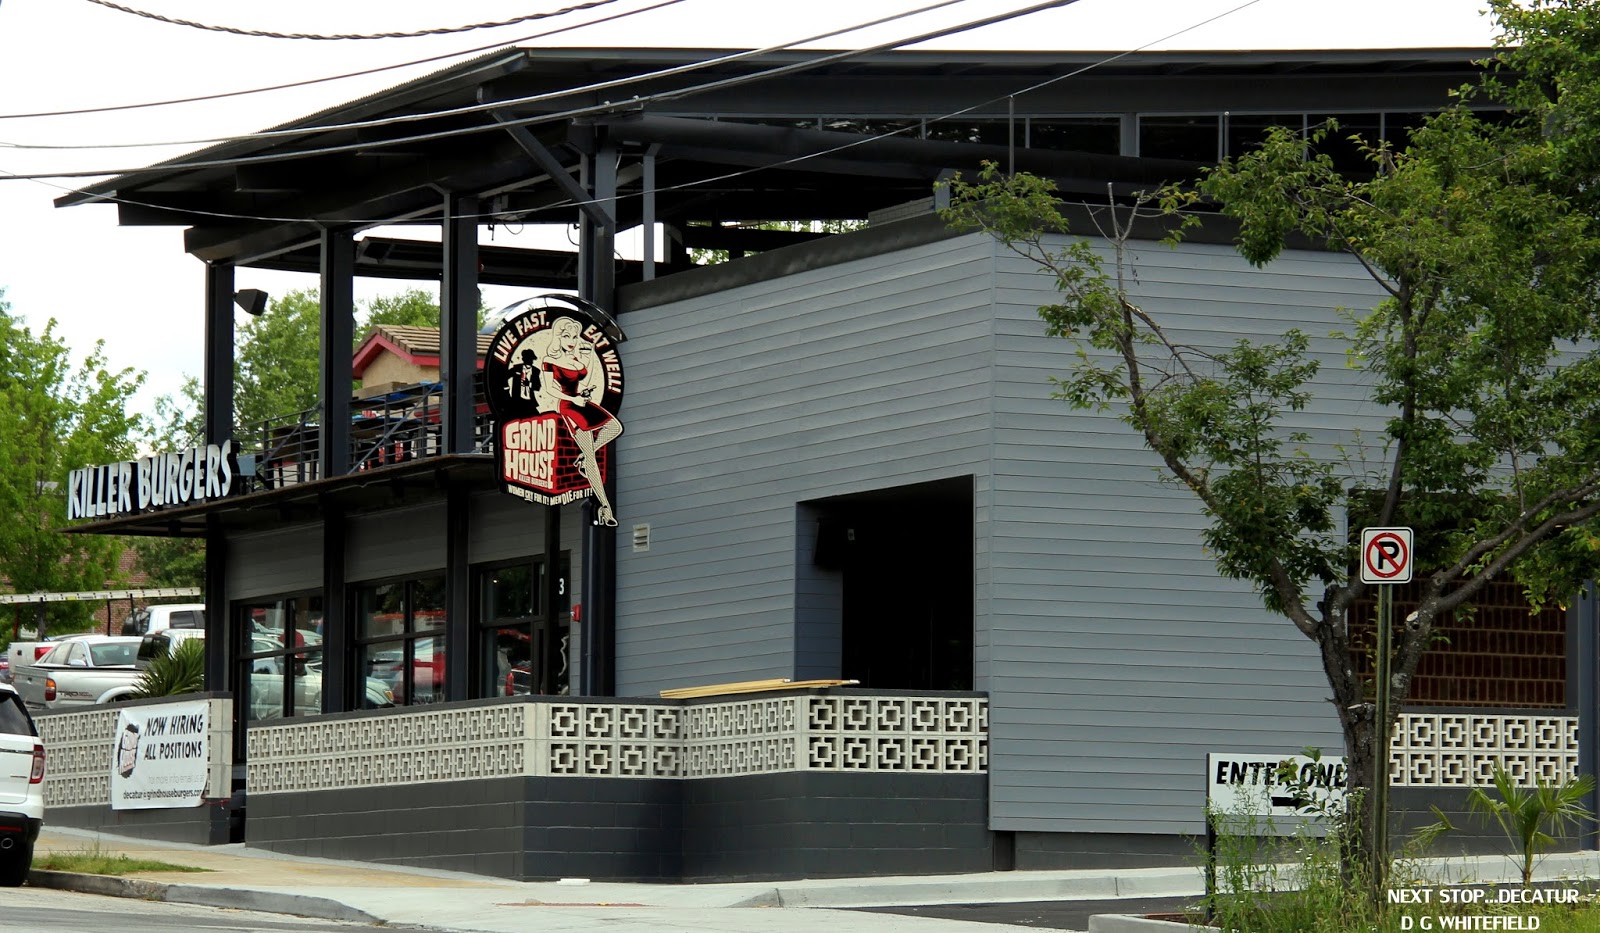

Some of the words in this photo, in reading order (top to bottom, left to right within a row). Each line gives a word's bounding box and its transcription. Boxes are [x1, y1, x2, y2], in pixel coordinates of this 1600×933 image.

[493, 329, 518, 362] LIVE
[515, 311, 550, 335] FAST,
[583, 324, 610, 347] EAT
[602, 350, 622, 393] WELL!
[505, 418, 556, 452] GRIND
[68, 460, 132, 520] KILLER
[137, 439, 232, 510] BURGERS
[504, 449, 555, 490] HOUSE
[507, 484, 524, 498] WOMEN
[534, 493, 542, 503] FOR
[550, 495, 561, 506] MEN
[561, 490, 573, 505] DIE
[573, 489, 583, 500] FOR
[584, 488, 593, 498] IT!
[144, 716, 168, 737] NOW
[169, 714, 204, 735] HIRING
[144, 743, 156, 760] ALL
[159, 741, 202, 760] POSITIONS
